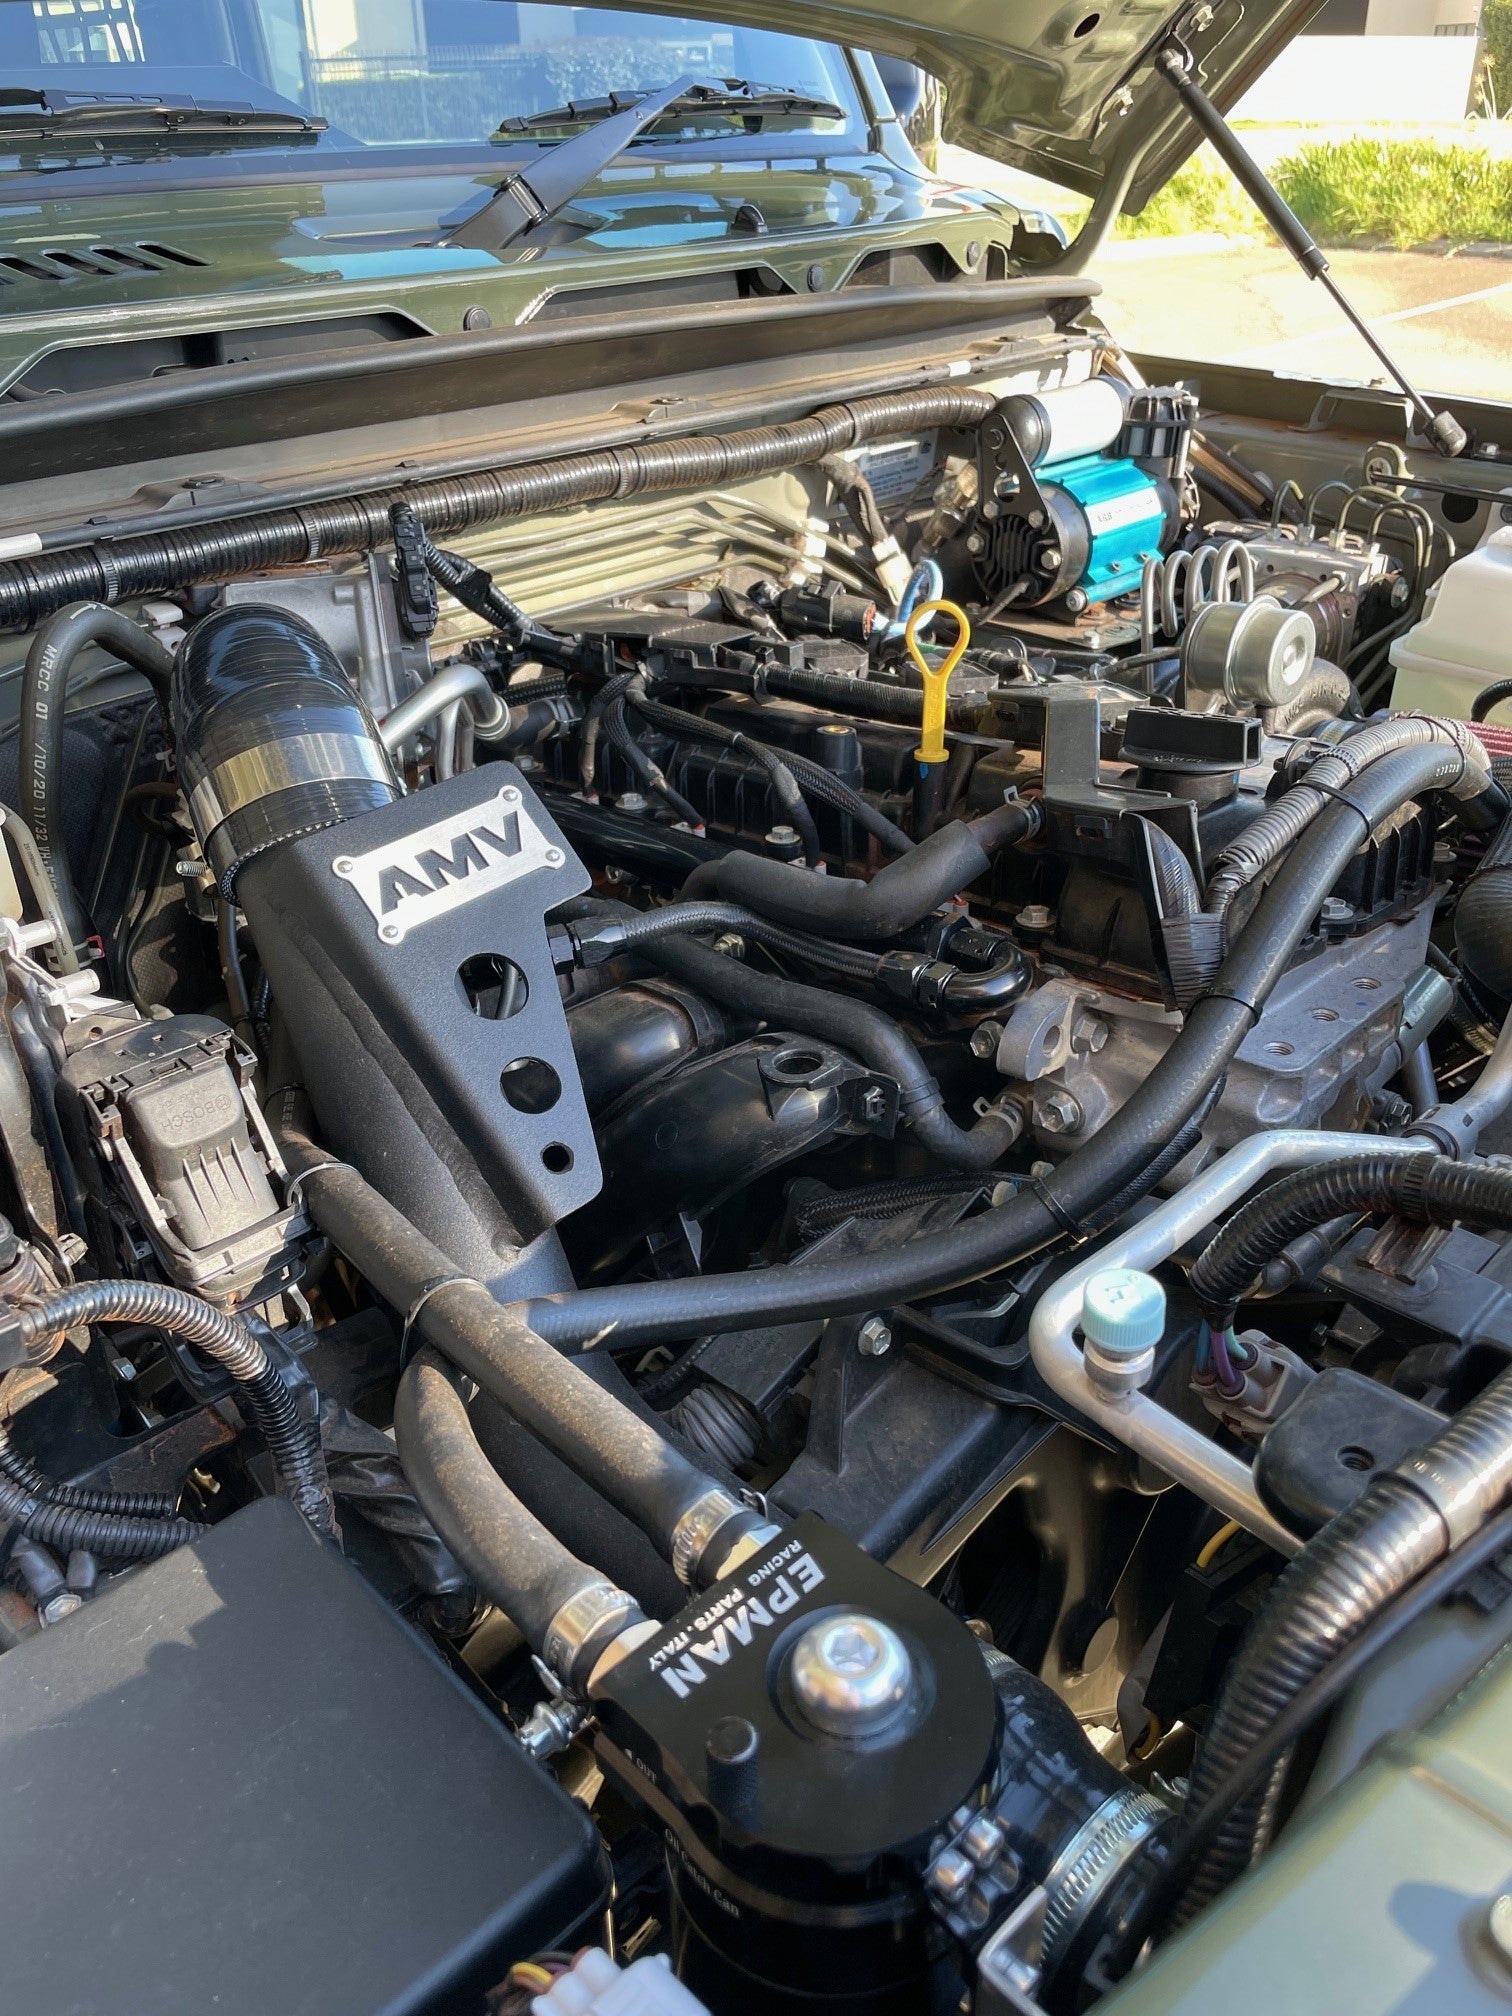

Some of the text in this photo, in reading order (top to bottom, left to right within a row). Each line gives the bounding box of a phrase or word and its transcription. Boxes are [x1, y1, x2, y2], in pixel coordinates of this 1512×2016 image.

[37, 643, 58, 692] MRCC
[378, 810, 522, 916] AMV
[161, 1101, 215, 1133] BOSCH
[748, 1539, 803, 1587] RACING
[660, 1552, 826, 1699] EPMAN
[649, 1631, 691, 1672] ITALY
[636, 1757, 657, 1783] OUT
[664, 1828, 680, 1853] Oil
[713, 1889, 740, 1919] Can
